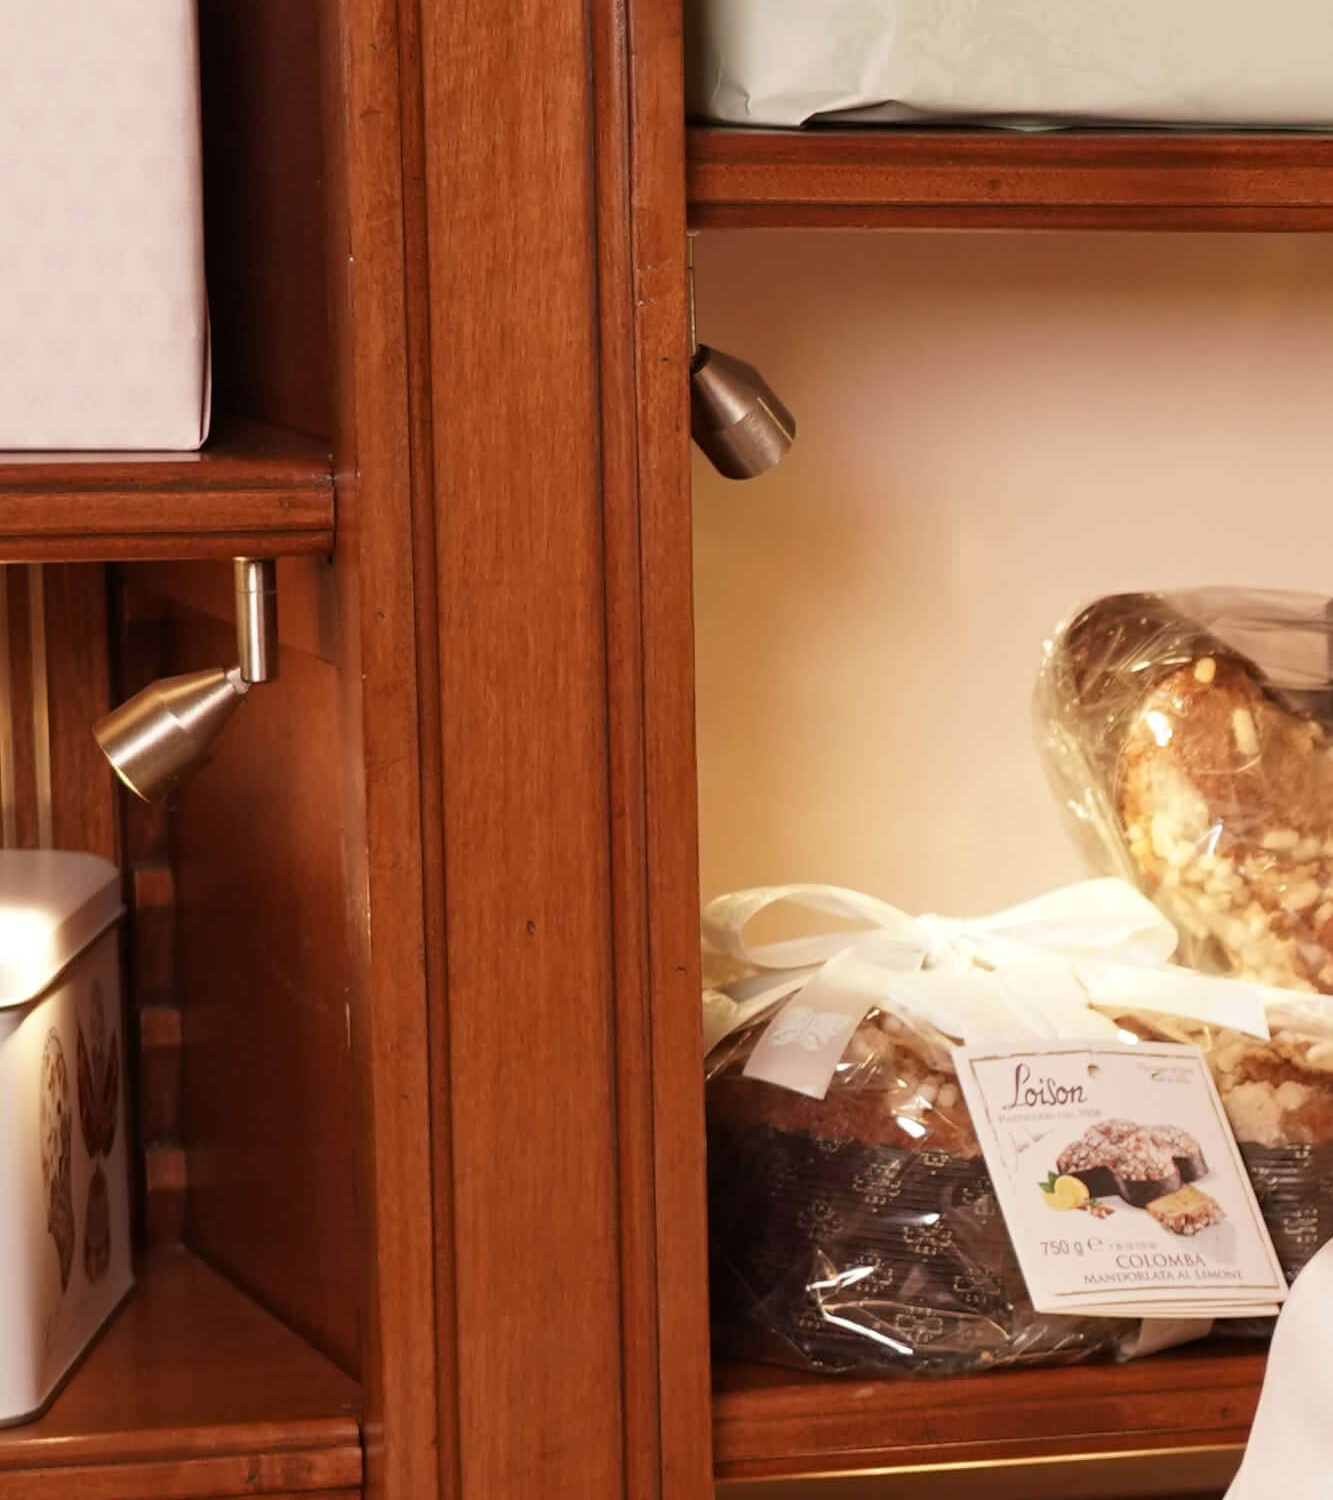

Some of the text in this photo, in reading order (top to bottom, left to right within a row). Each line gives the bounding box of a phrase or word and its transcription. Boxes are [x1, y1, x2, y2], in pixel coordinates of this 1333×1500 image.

[1001, 1063, 1088, 1110] Loison
[1040, 1240, 1084, 1257] 750 g
[1116, 1253, 1206, 1270] COLOMBA
[1084, 1269, 1244, 1285] MANDORLATA AL LIMONE
